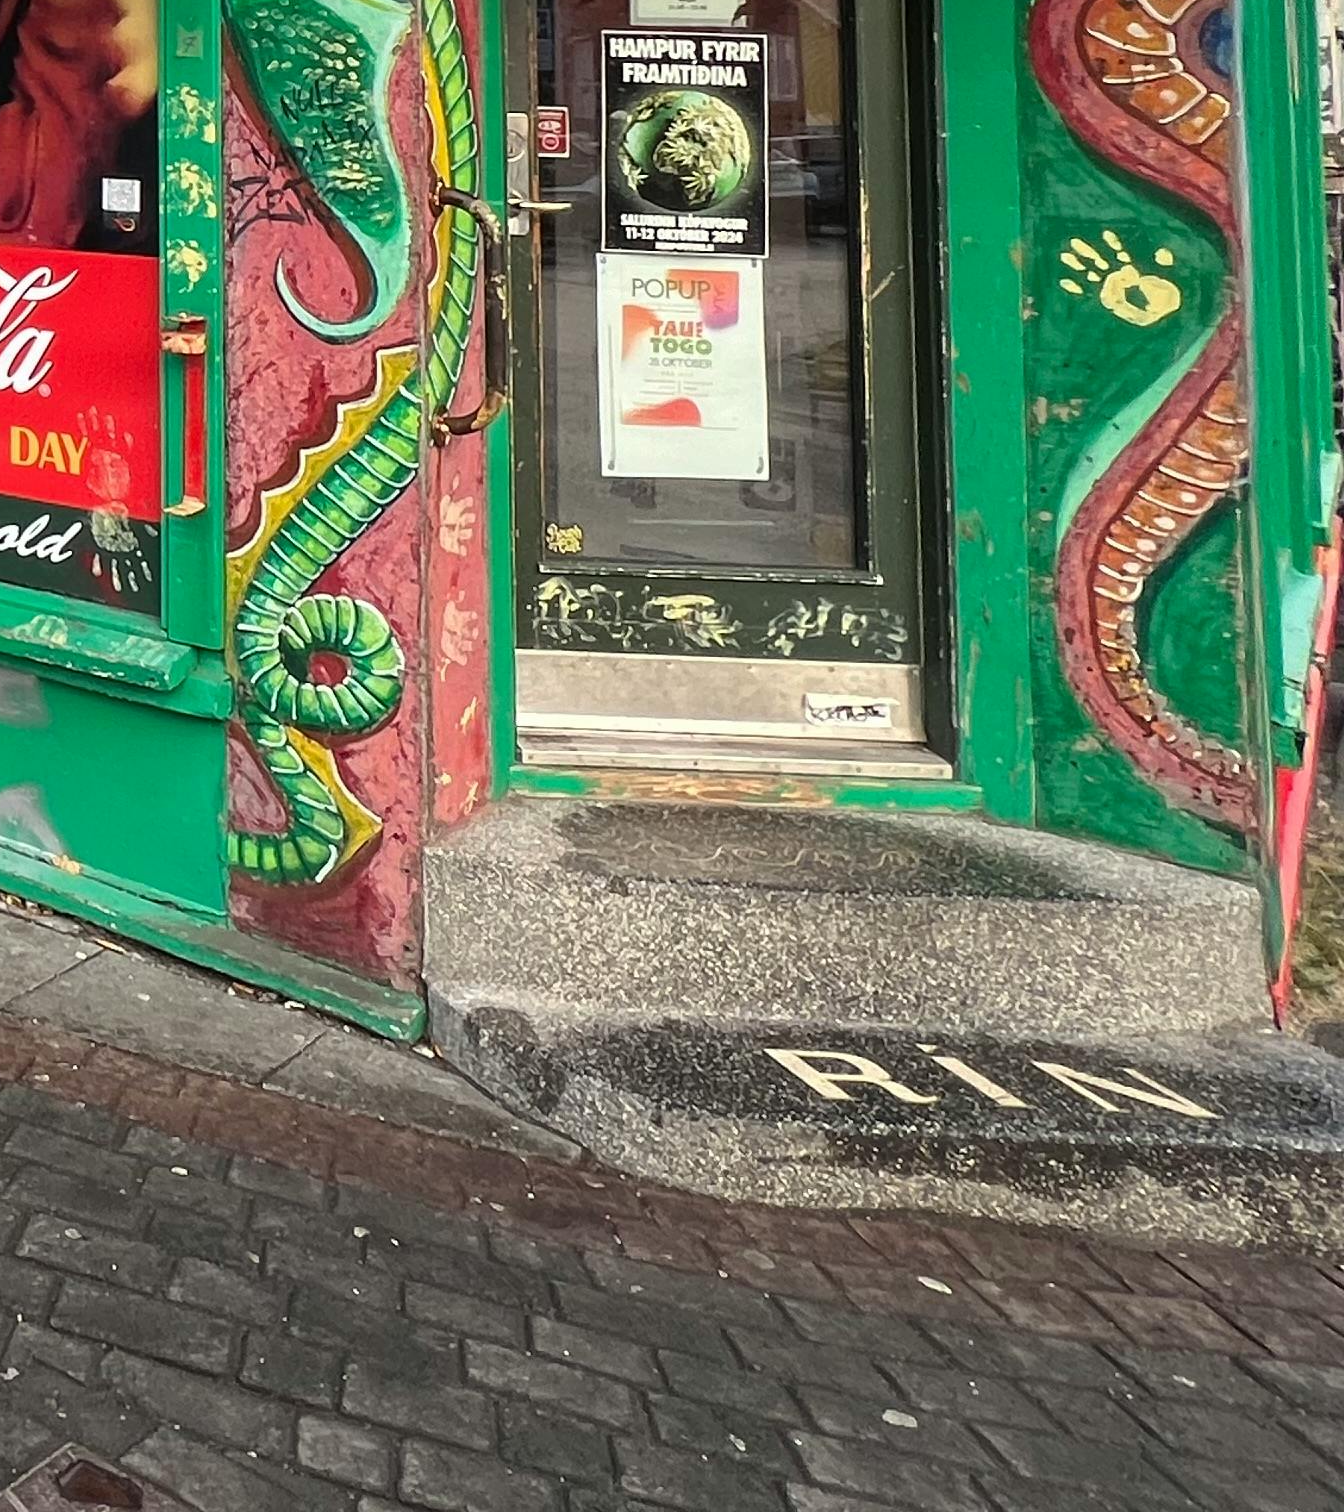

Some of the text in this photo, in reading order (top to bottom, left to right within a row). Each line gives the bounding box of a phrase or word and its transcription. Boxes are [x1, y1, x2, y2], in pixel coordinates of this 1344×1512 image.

[609, 37, 760, 63] HAMPUR FYRIR
[10, 430, 89, 476] DAY
